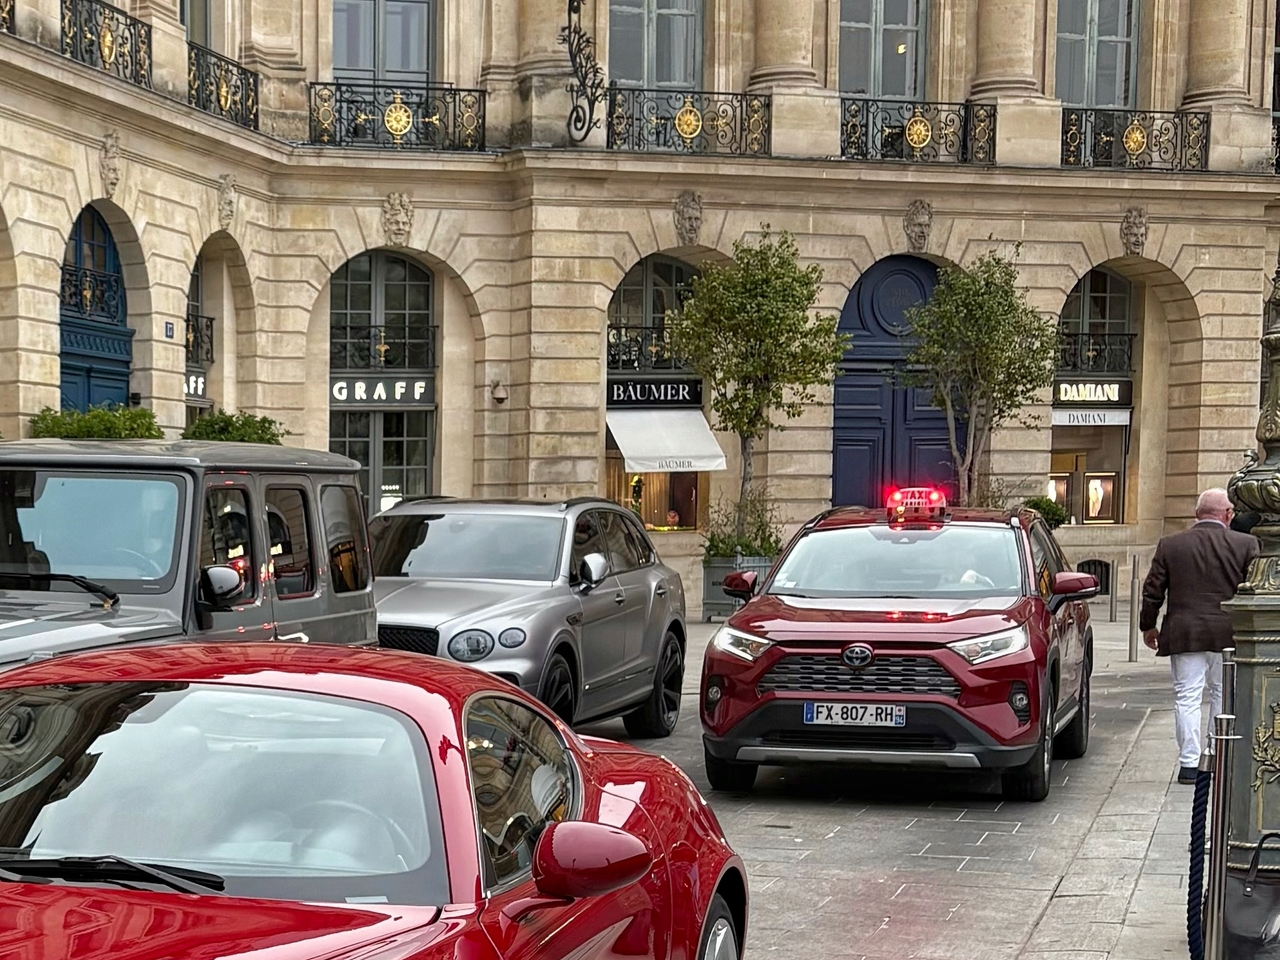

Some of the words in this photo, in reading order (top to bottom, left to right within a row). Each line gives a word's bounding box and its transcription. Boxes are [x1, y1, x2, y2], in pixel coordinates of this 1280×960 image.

[332, 381, 426, 401] GRAFF
[613, 382, 691, 400] BÄUMER
[1060, 383, 1120, 401] DAMIANI
[1068, 413, 1106, 424] DAMIANI
[903, 490, 928, 500] TAXI
[815, 704, 894, 722] FX-807-RH
[894, 715, 904, 724] 94
